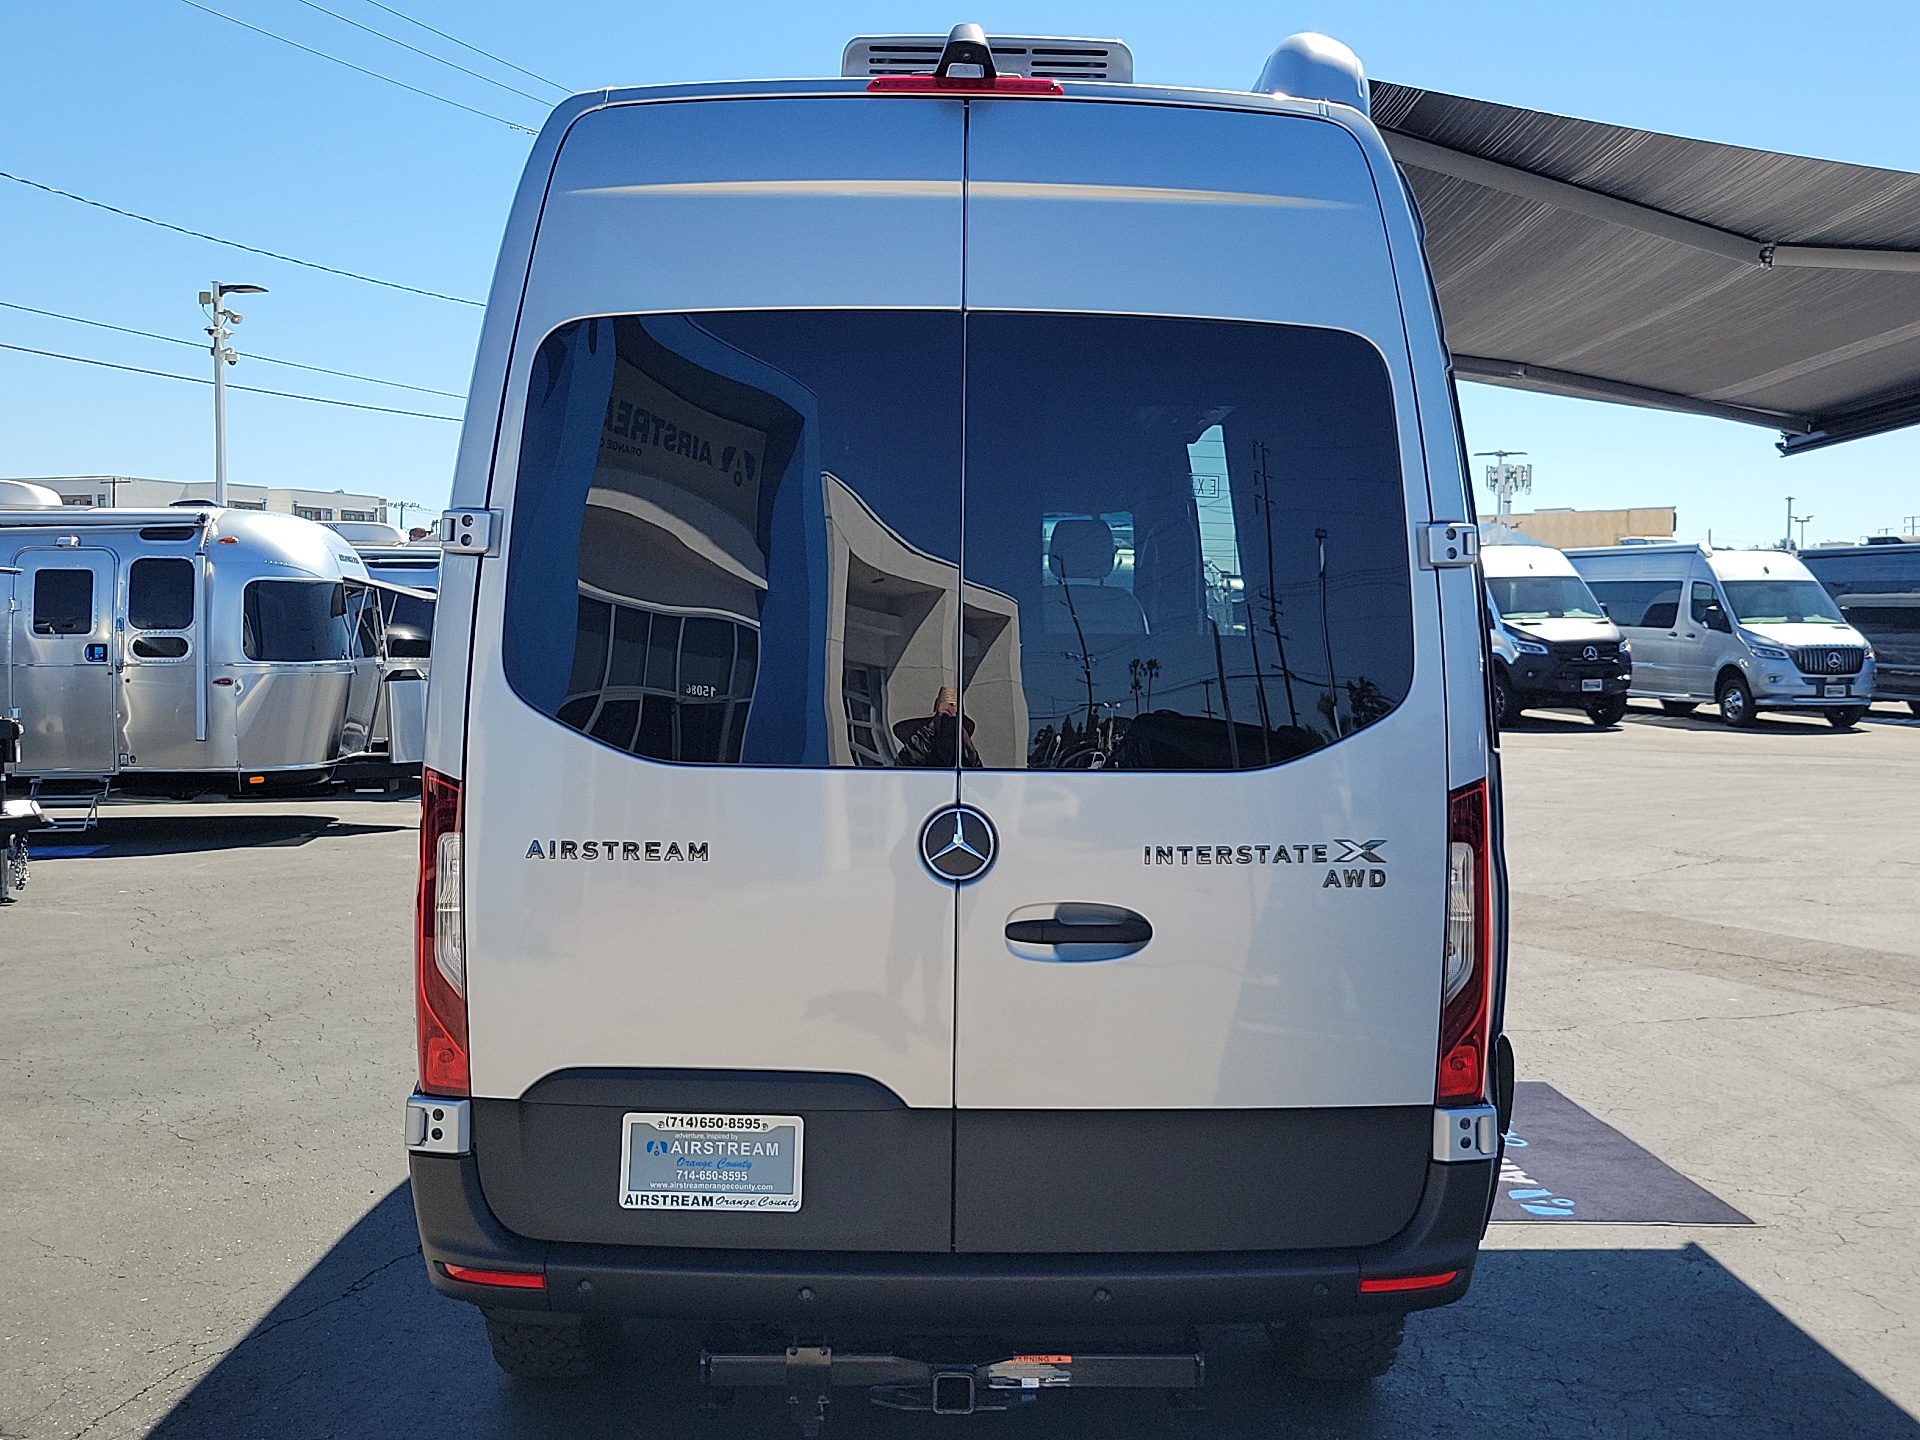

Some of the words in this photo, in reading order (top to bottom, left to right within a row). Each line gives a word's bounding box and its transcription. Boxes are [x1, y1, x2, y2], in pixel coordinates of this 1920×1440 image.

[525, 839, 709, 862] AIRSTREAM
[1322, 869, 1387, 888] AWD
[670, 1140, 780, 1157] AIRSTREAM
[676, 1156, 713, 1172] Orange
[717, 1157, 753, 1171] County
[676, 1169, 749, 1182] 714-650-8595
[649, 1181, 774, 1192] www.airstreamorangecounty.com
[624, 1193, 714, 1207] AIRSTREAM
[715, 1195, 756, 1209] Orange
[757, 1196, 800, 1209] County
